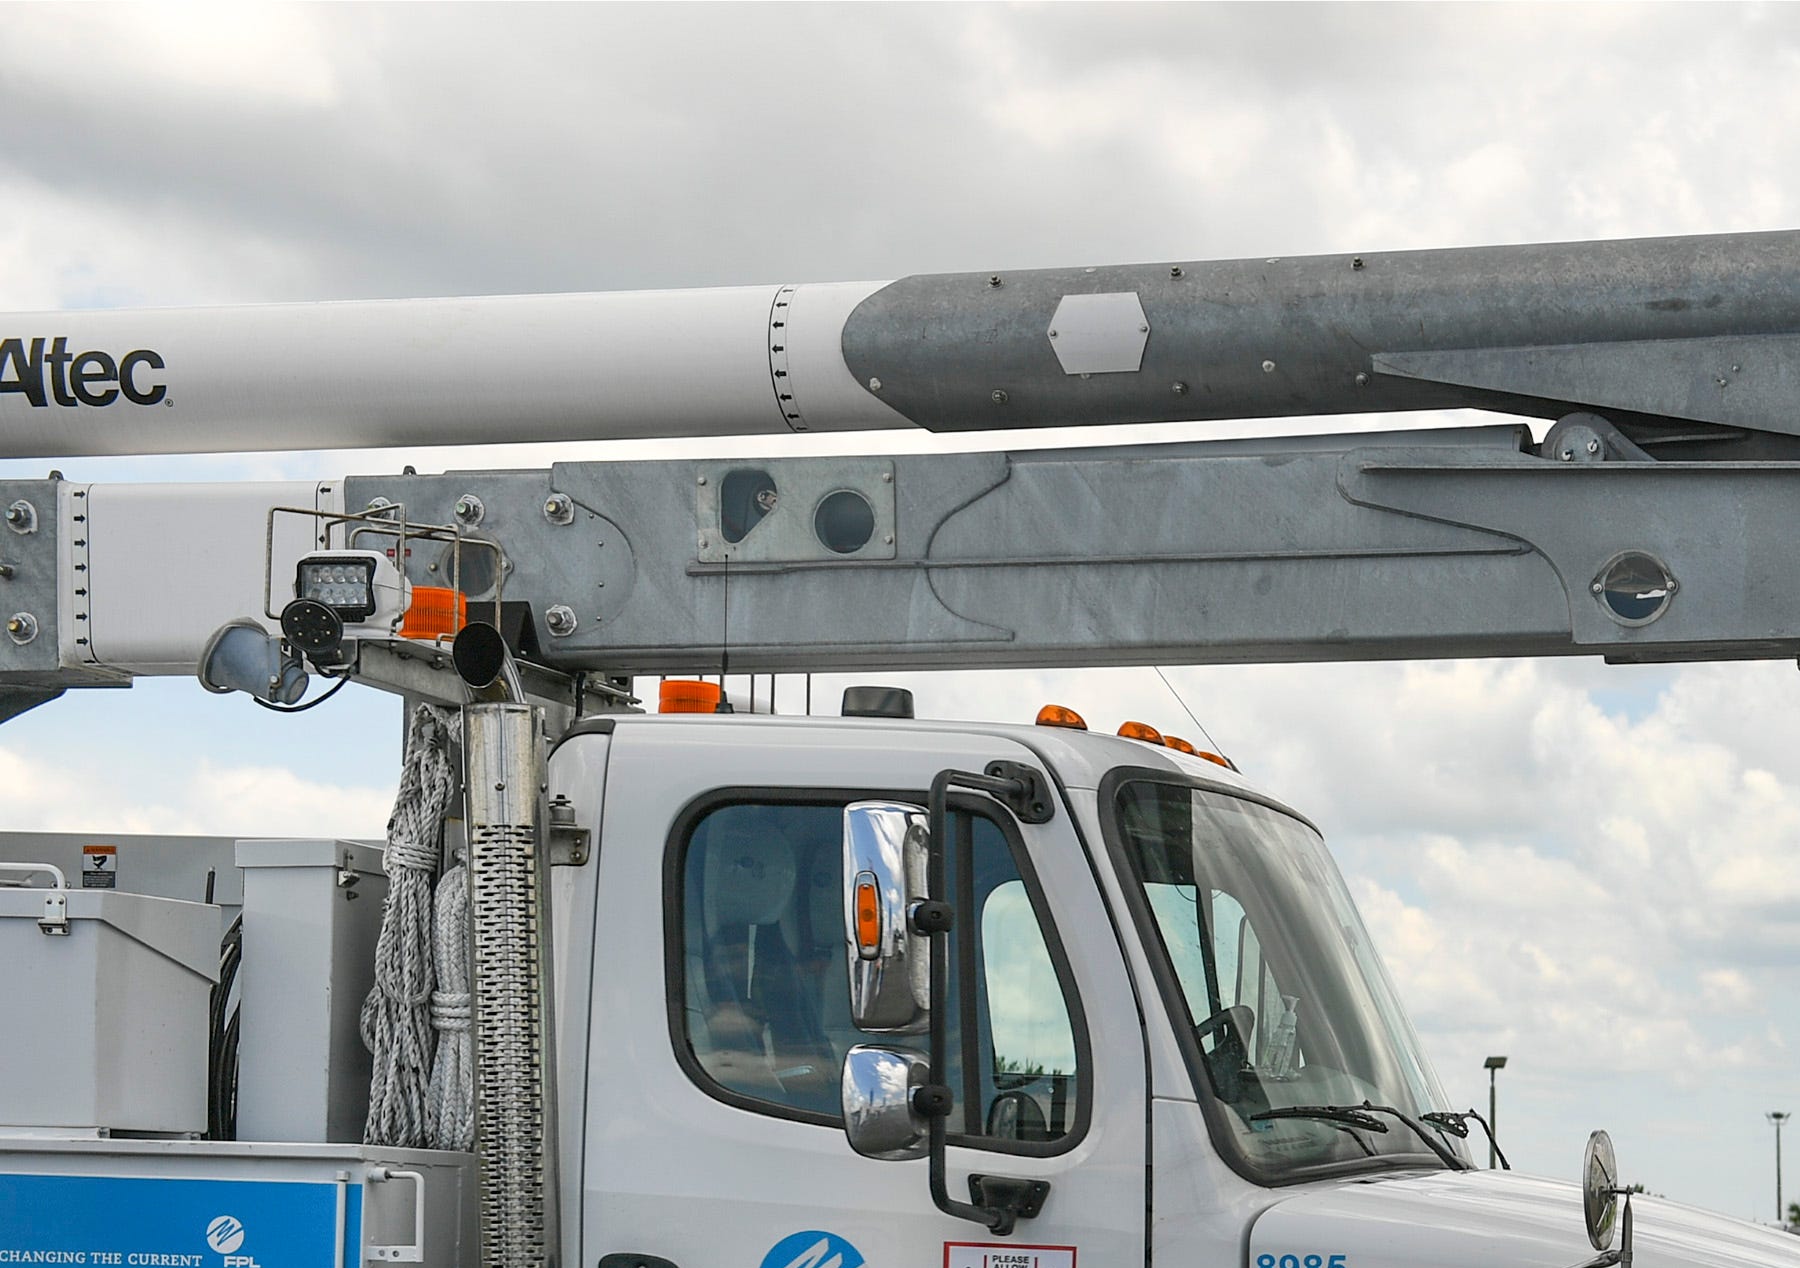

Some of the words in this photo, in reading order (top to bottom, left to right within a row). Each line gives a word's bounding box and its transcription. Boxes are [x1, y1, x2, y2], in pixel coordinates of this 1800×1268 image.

[0, 336, 167, 407] Altec
[0, 1250, 86, 1264] CHANGING
[91, 1252, 122, 1264] THE
[128, 1254, 203, 1267] CURRENT
[224, 1256, 260, 1268] FPL
[992, 1255, 1030, 1264] PLEASE
